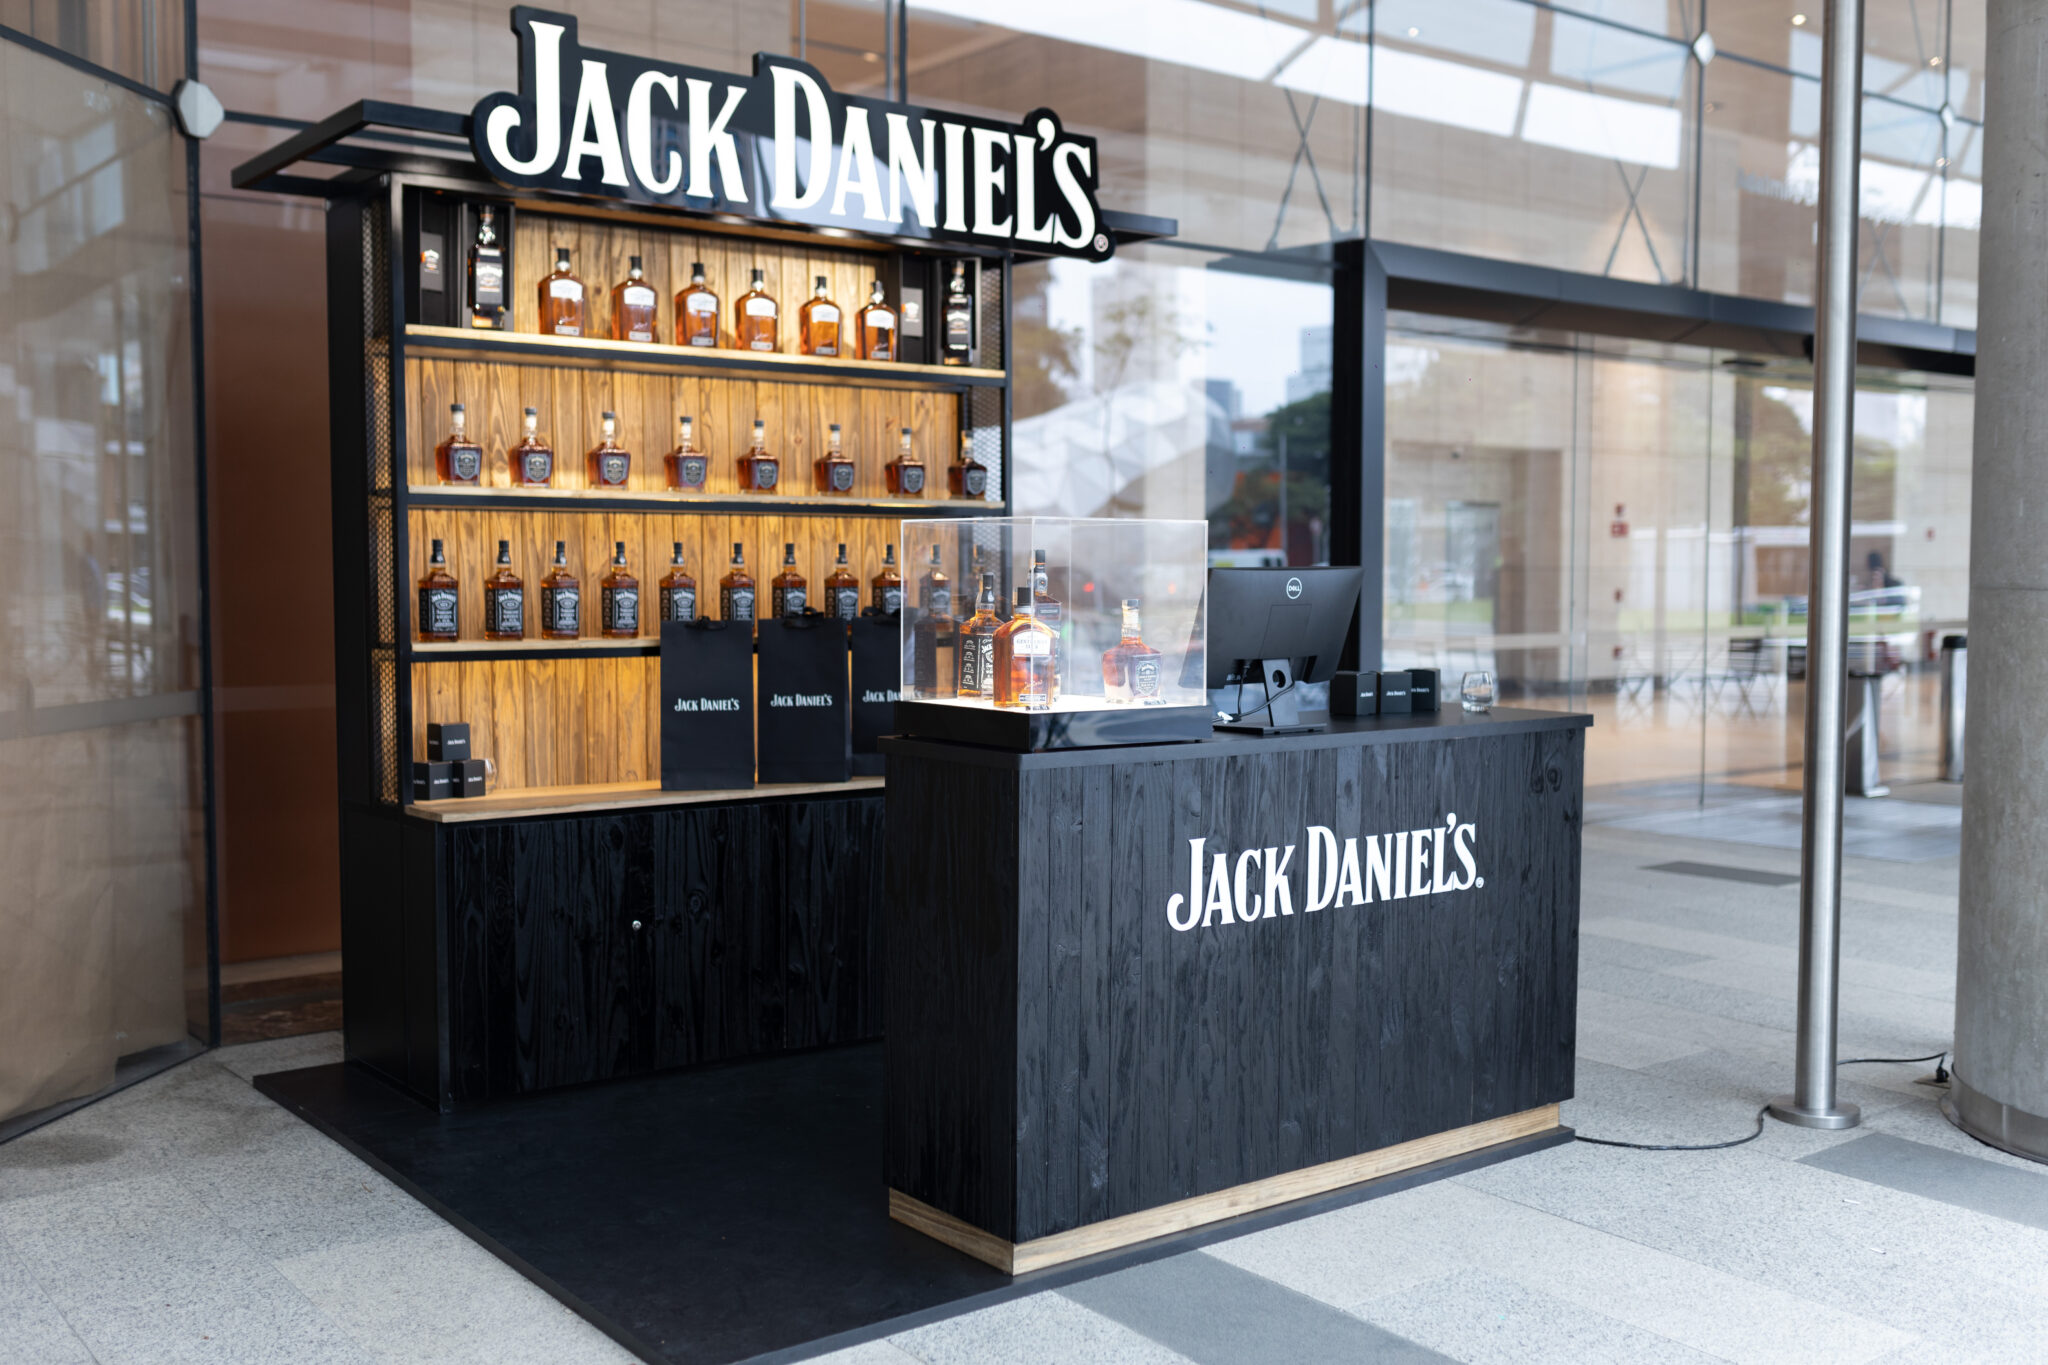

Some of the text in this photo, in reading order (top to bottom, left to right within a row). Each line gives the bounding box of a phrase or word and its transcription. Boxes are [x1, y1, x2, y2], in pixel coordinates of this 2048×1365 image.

[486, 20, 1097, 250] JACK DANIEL'S
[770, 693, 833, 707] JACK DANIEL'S
[862, 689, 886, 703] JACK
[674, 697, 740, 712] JACK DANIEL'S
[1166, 812, 1477, 932] JACK DANIEL'S
